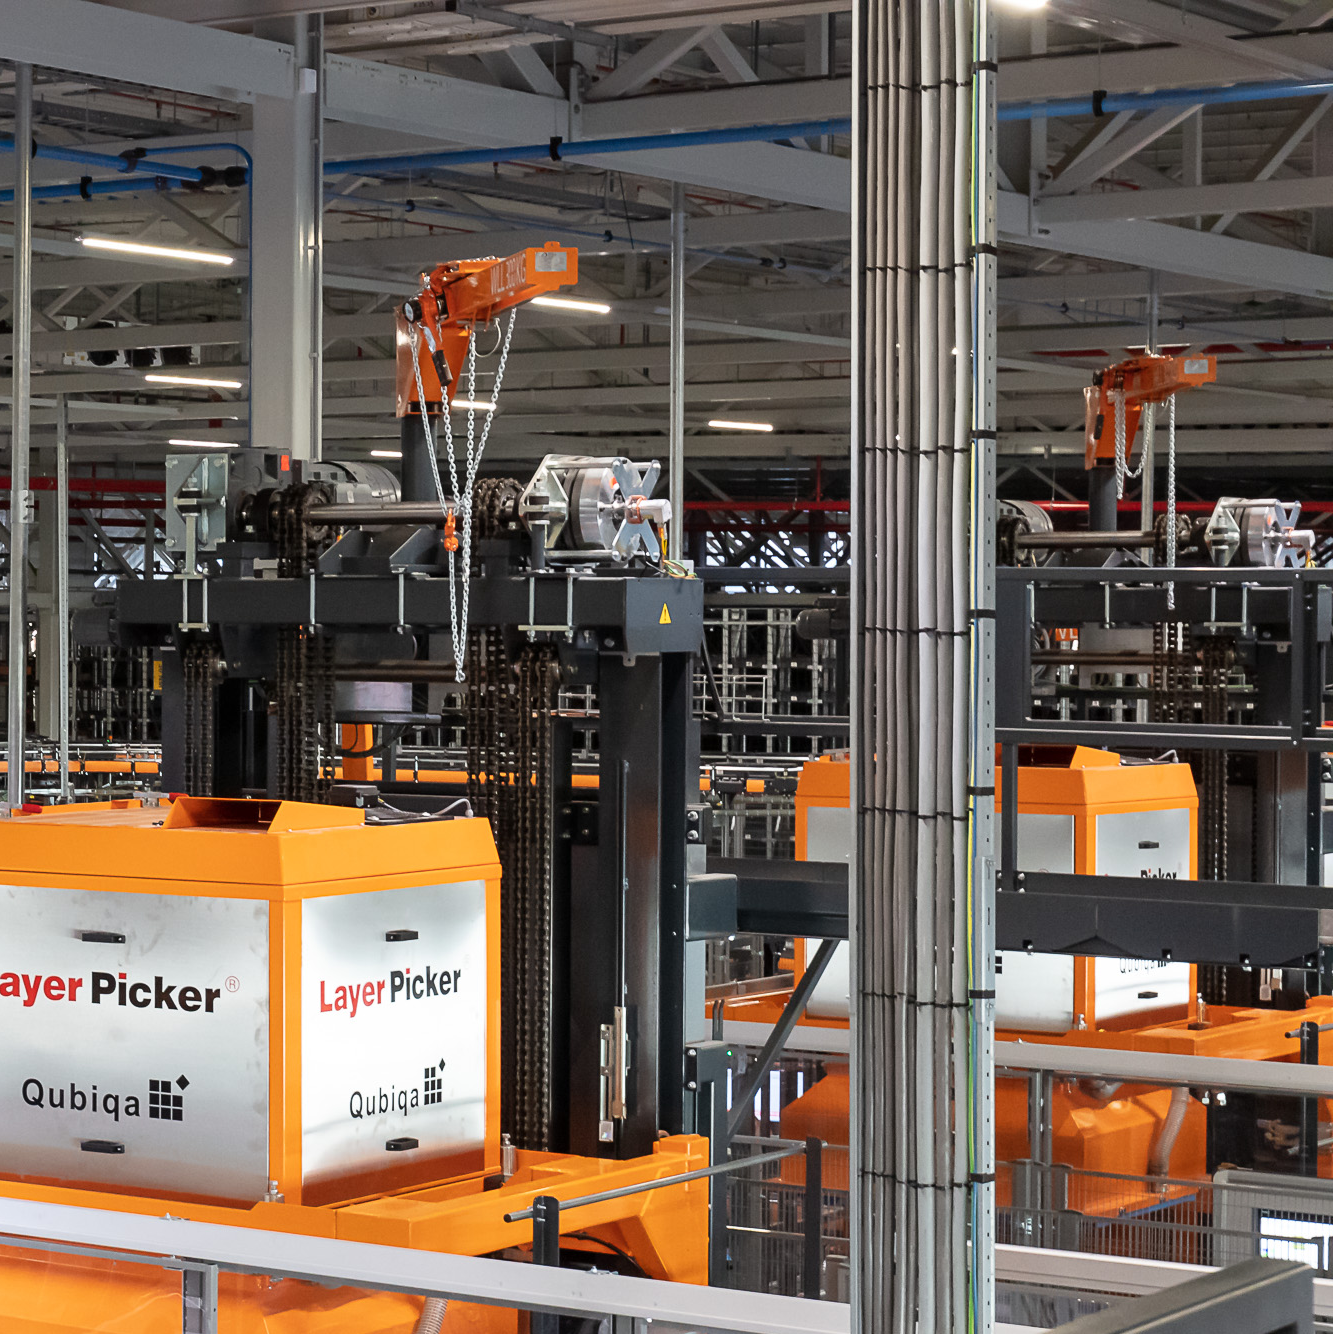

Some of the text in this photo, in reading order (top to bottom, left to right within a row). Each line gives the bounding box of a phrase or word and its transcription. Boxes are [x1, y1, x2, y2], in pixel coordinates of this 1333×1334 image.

[320, 967, 461, 1017] Layer Picker
[21, 1078, 141, 1122] Qubiqa
[349, 1085, 419, 1119] Qubiqa
